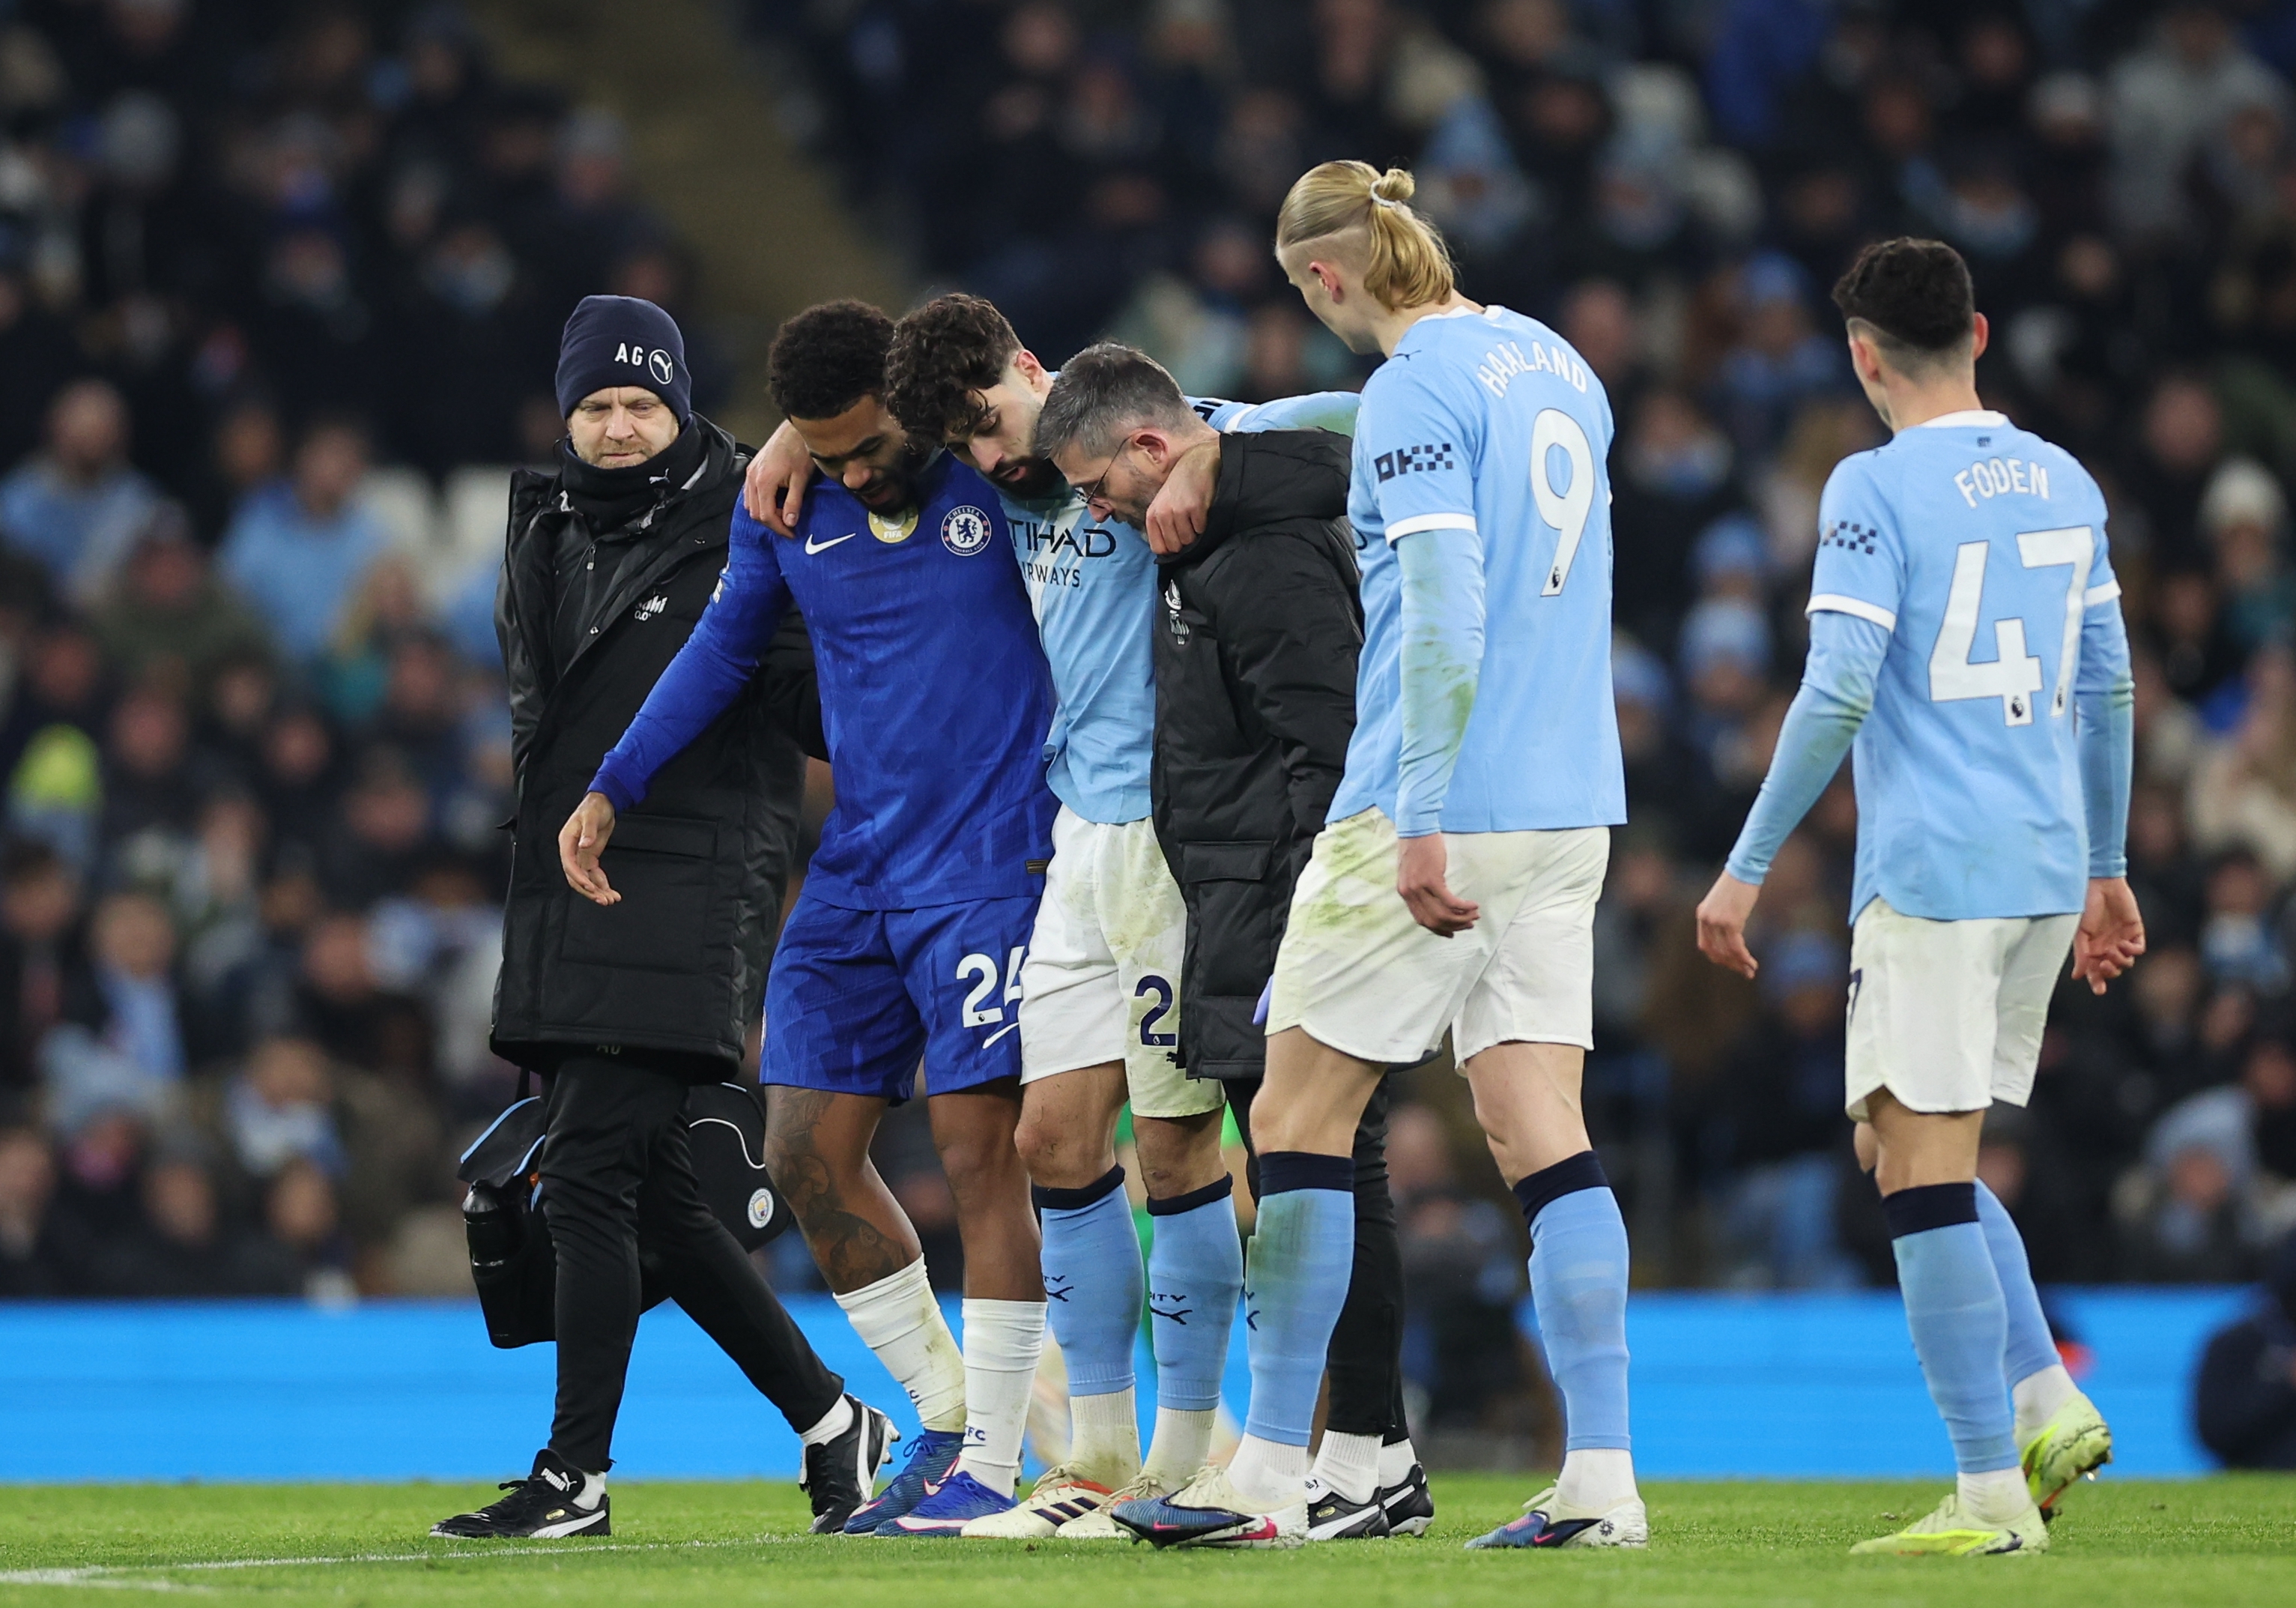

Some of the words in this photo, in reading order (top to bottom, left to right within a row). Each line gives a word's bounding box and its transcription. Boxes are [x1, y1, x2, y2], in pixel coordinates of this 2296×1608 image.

[614, 342, 643, 366] AG
[1477, 339, 1588, 399] HAALAND
[1374, 443, 1453, 484] OKX
[1953, 456, 2050, 509] FODEN
[948, 507, 980, 521] CHELSEA
[1530, 408, 1596, 597] 9
[884, 530, 903, 539] FIFA
[1008, 520, 1116, 557] TIHAD
[1021, 561, 1080, 588] IRWAYS
[1927, 525, 2095, 727] 47
[965, 1426, 987, 1441] FC
[541, 1467, 566, 1491] PUMA
